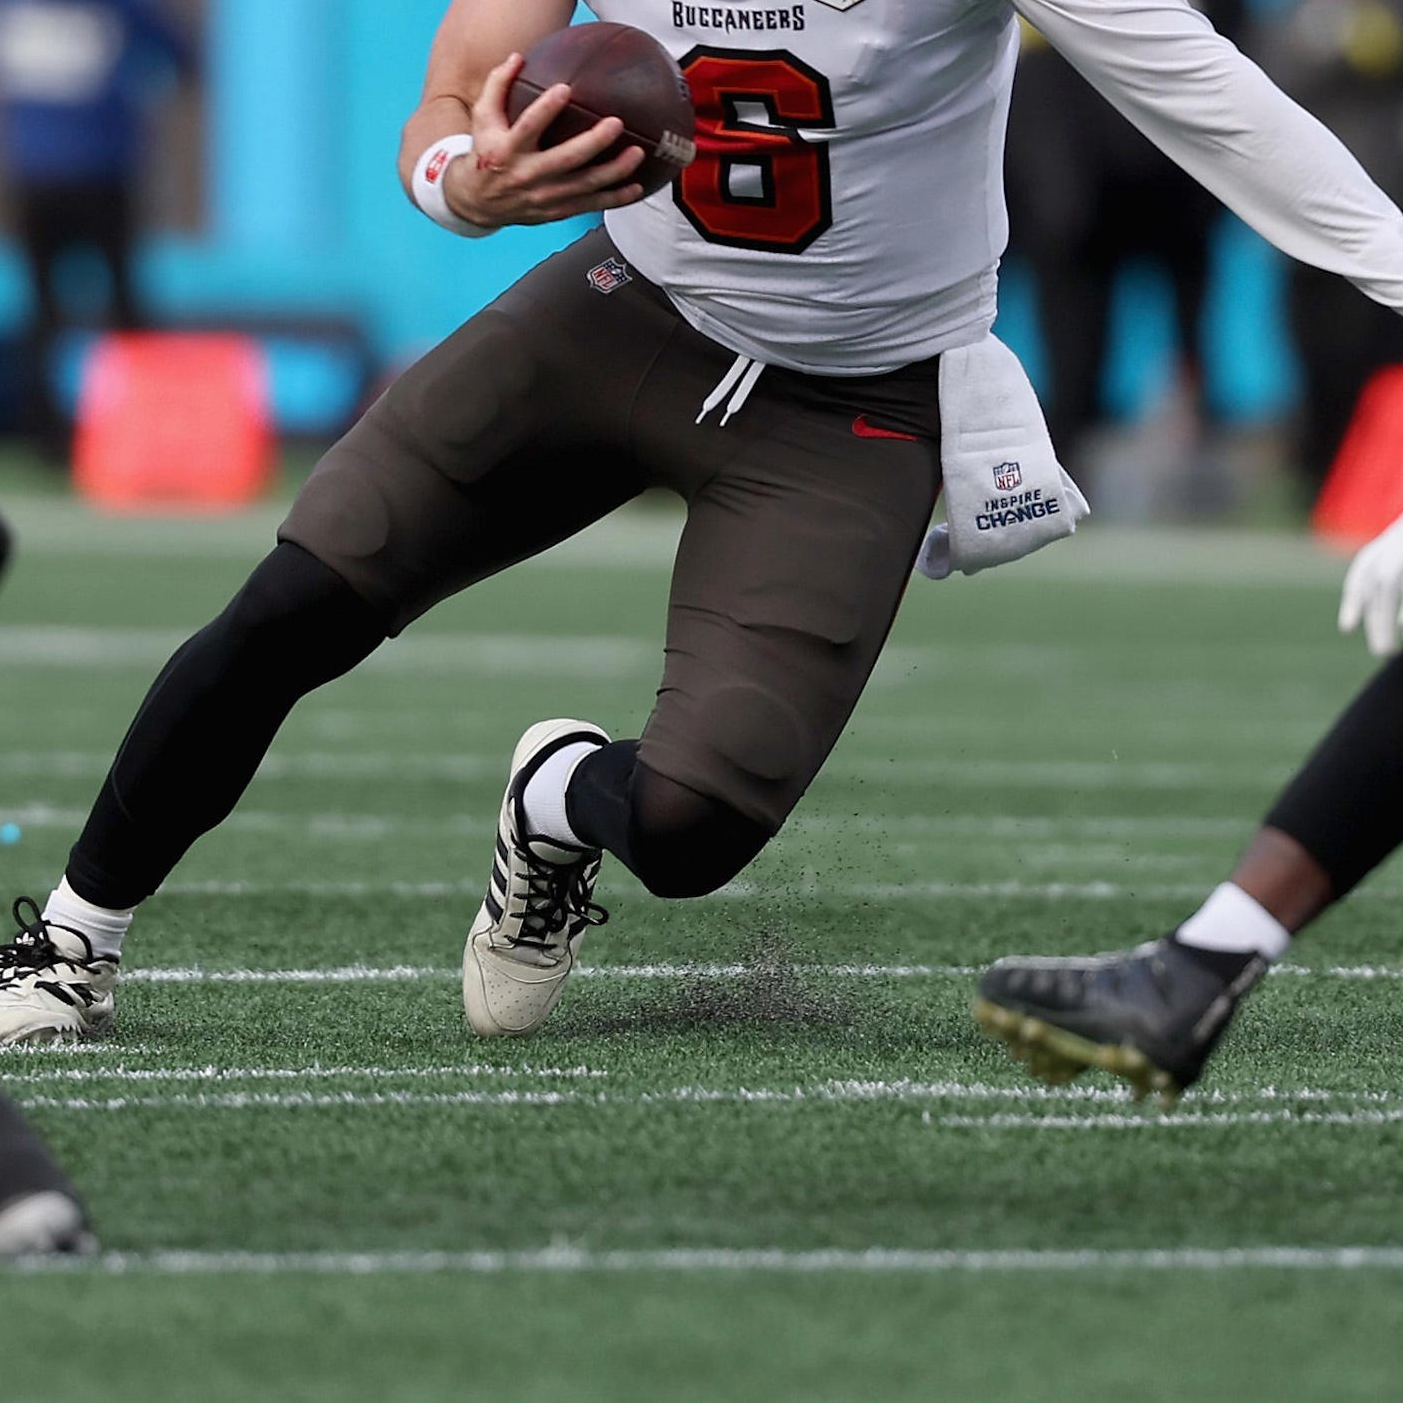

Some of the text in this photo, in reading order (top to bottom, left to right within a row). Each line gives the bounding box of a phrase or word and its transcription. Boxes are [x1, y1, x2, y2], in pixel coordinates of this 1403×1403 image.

[671, 0, 805, 34] BUCCANEERS
[672, 44, 835, 255] 6
[998, 473, 1021, 489] NFL
[976, 498, 1060, 530] CHANGE
[985, 489, 1042, 512] INSPIRE
